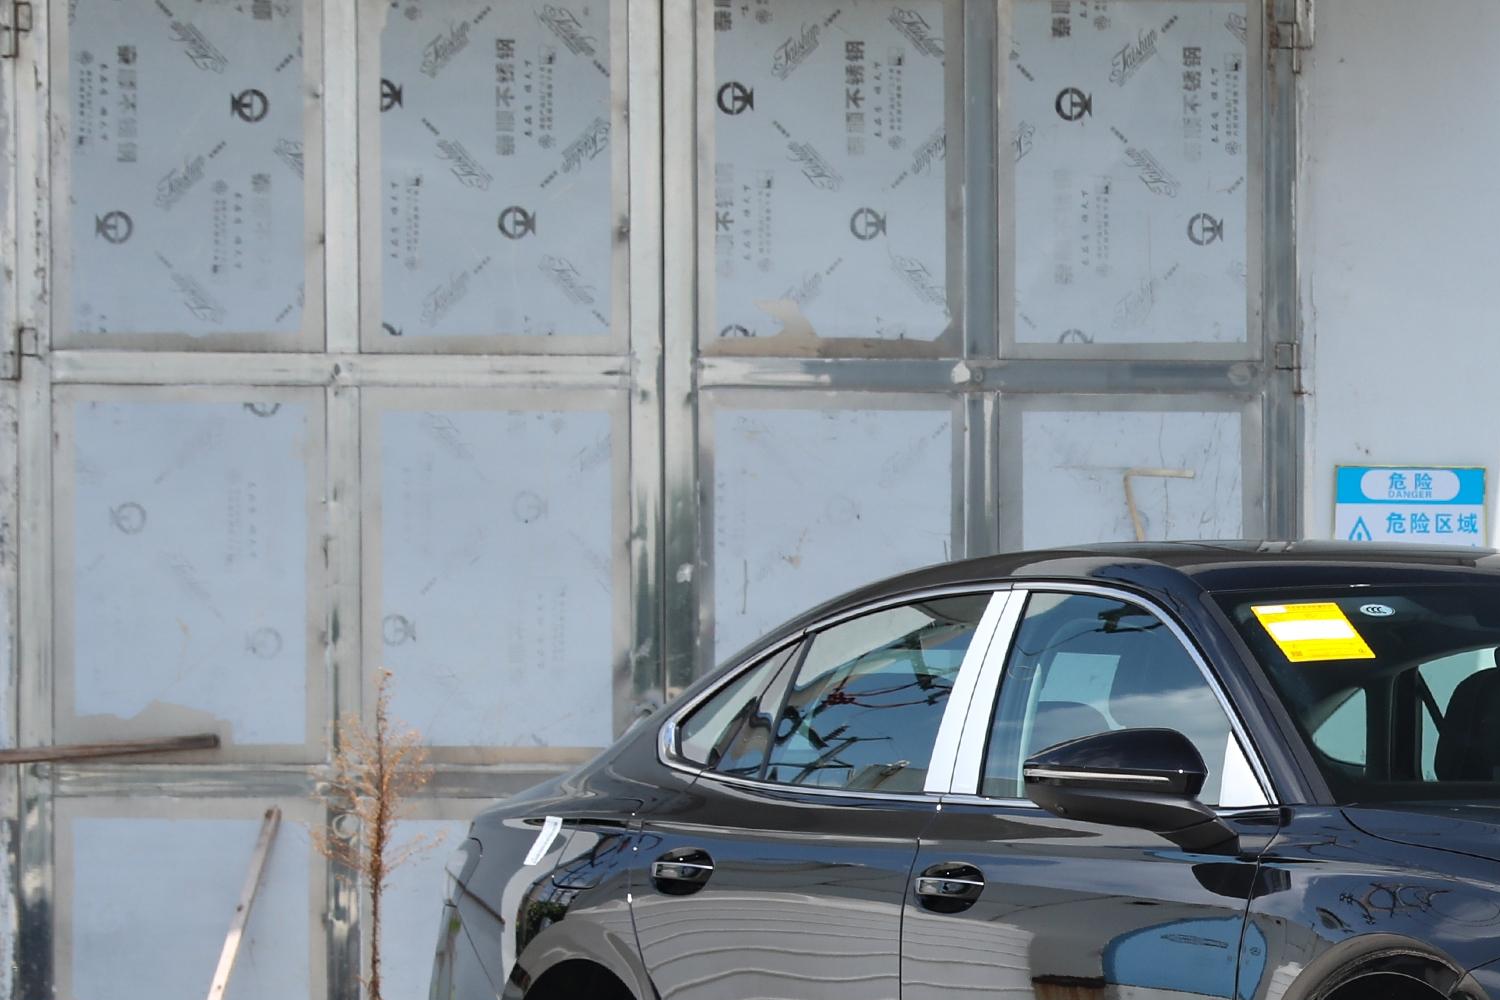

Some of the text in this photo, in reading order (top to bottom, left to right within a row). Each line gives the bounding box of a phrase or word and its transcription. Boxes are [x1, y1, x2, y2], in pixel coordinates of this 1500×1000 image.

[1182, 45, 1202, 163] 顺不锈钢
[1388, 472, 1433, 490] 危险
[1388, 490, 1433, 498] DANGER
[1385, 512, 1479, 534] 危险区域
